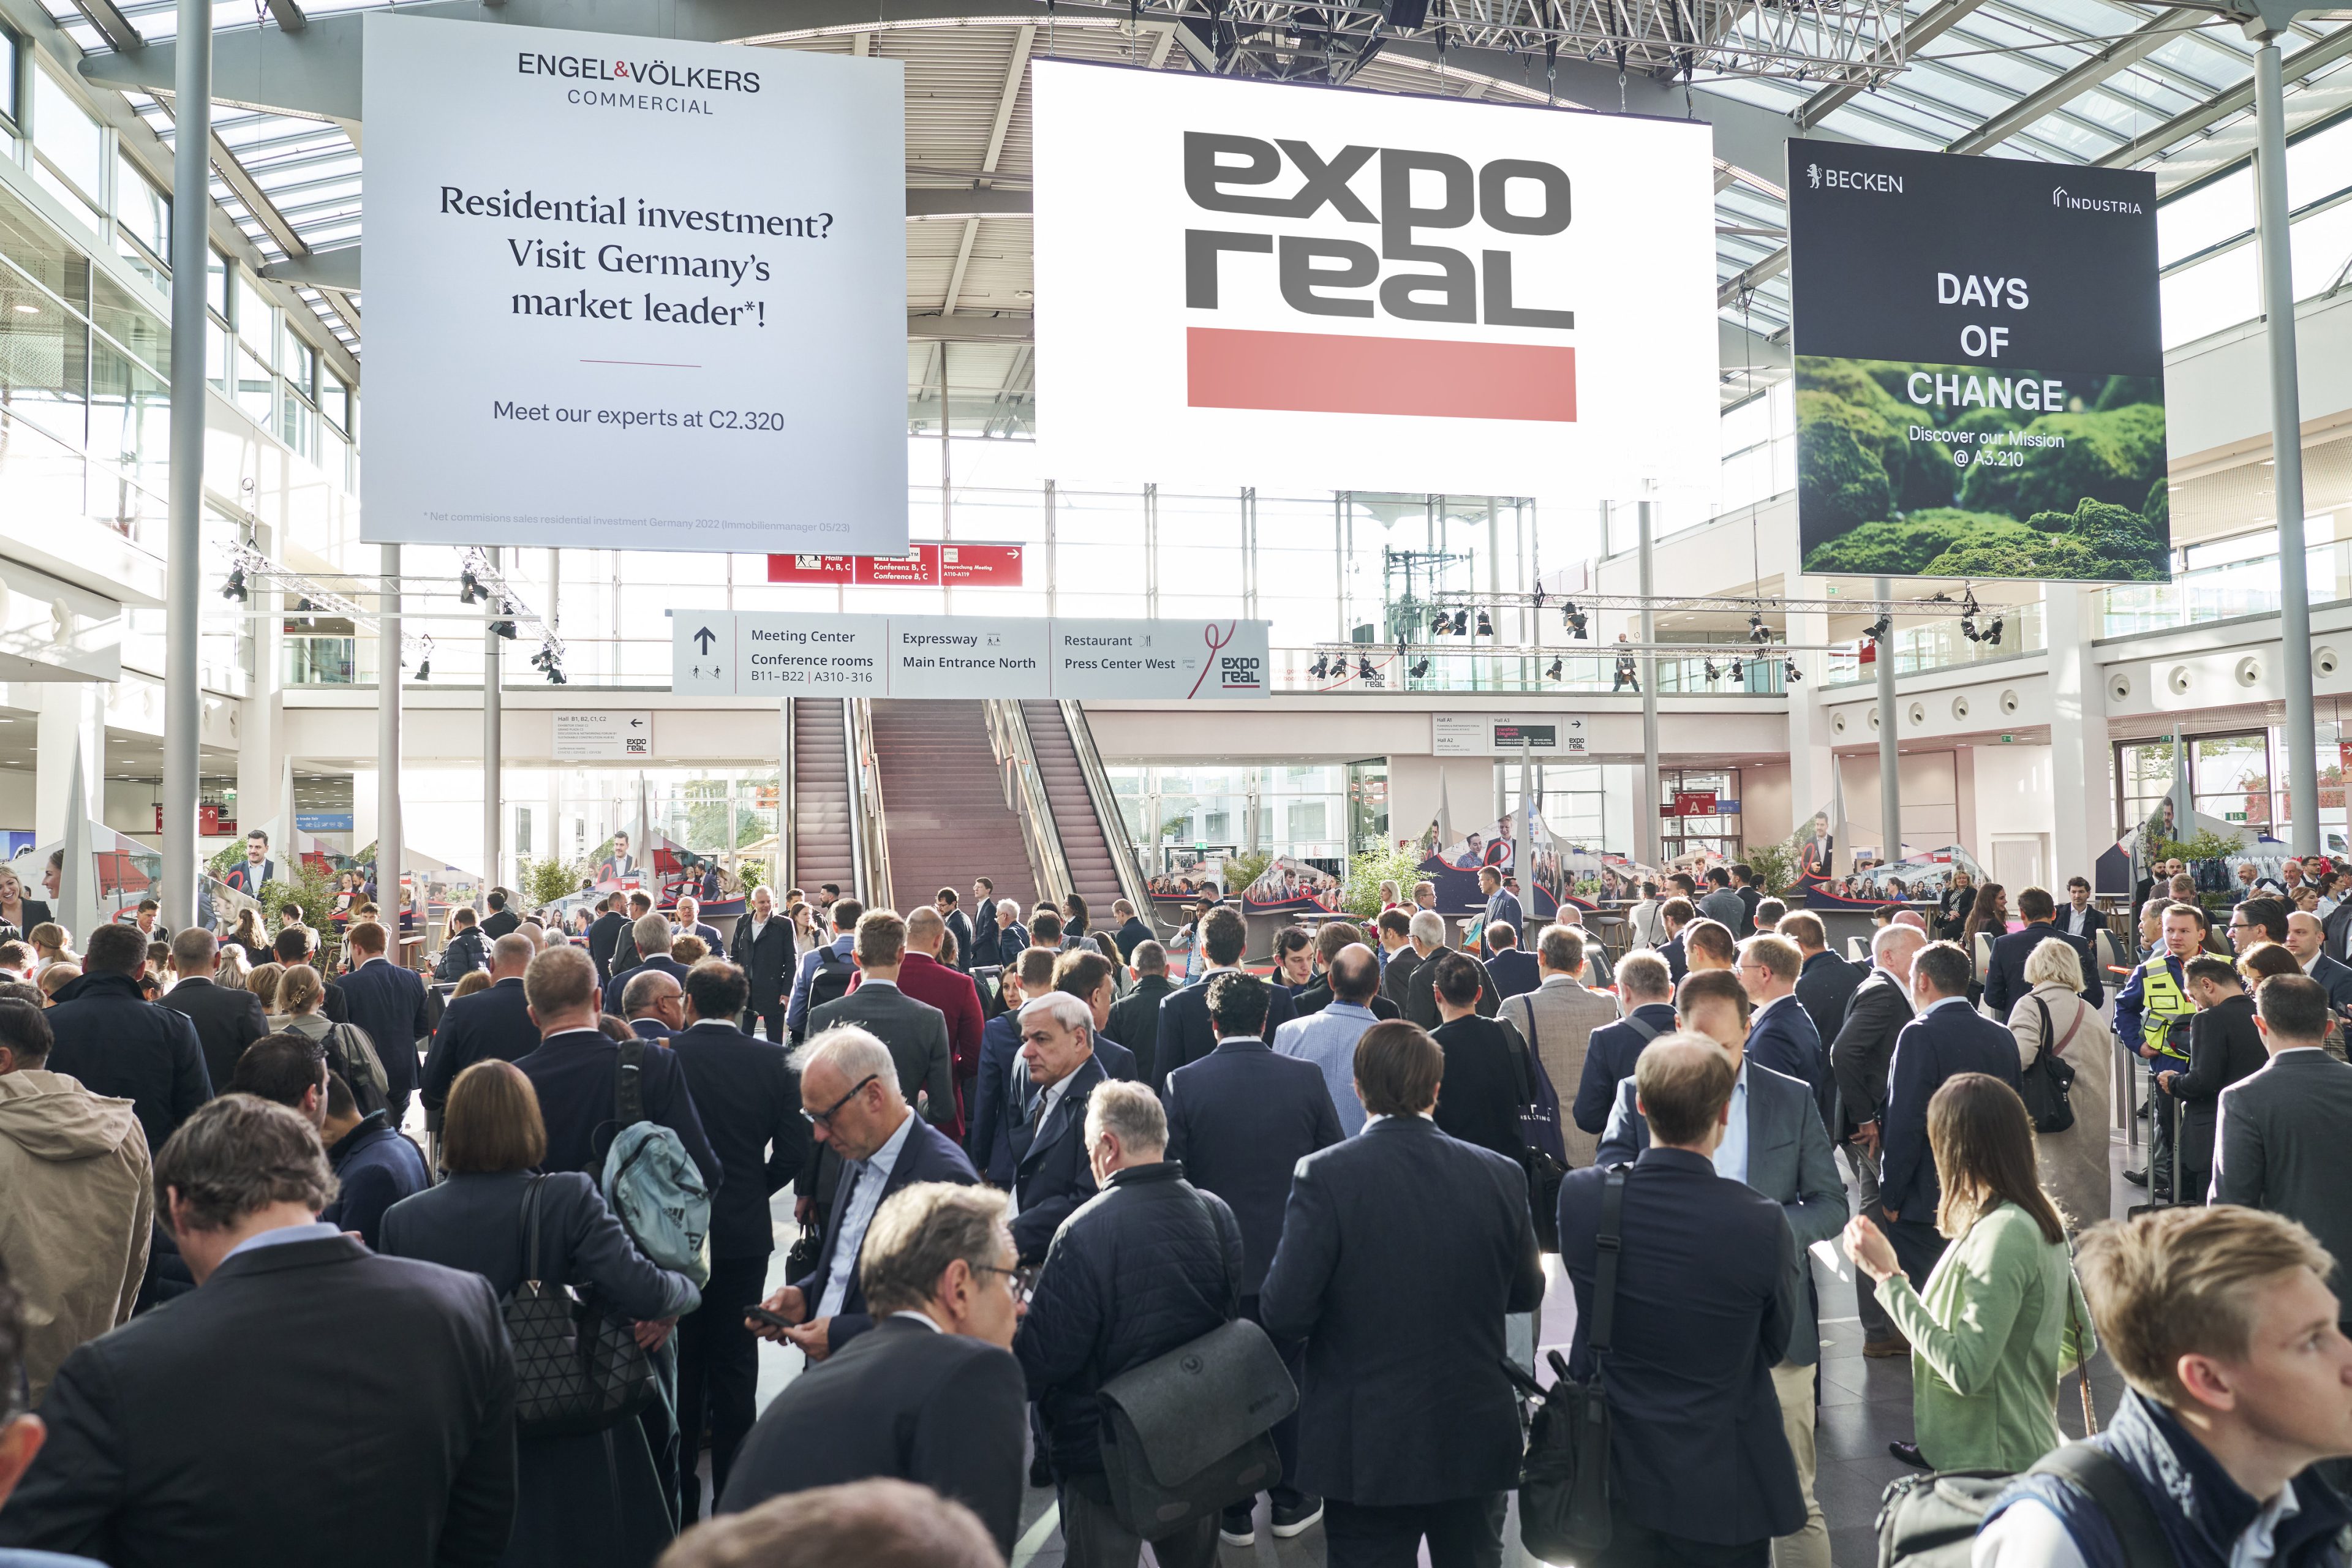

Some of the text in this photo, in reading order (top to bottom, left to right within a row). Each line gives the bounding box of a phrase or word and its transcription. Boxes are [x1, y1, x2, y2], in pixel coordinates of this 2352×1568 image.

[518, 52, 760, 94] ENGEL&VÖLKERS
[568, 89, 713, 115] COMMERCIAL
[1826, 170, 1902, 193] BECKEN
[1184, 130, 1571, 258] expo
[441, 187, 833, 238] Residential investment?
[2067, 197, 2141, 214] INDUSTRIA
[507, 239, 769, 287] Visit Germany’s
[1938, 273, 2029, 309] DAYS
[512, 289, 632, 320] market
[1961, 325, 2008, 357] OF
[1907, 372, 2063, 412] CHANGE
[495, 401, 783, 431] Meet our experts at C2.320
[1910, 426, 2064, 448] Discover our Mission
[1954, 451, 2023, 467] @ A3.210
[431, 512, 448, 521] Net
[451, 513, 511, 522] commisions
[513, 514, 538, 523] sales
[541, 515, 590, 524] residential
[594, 516, 647, 526] investment
[650, 518, 693, 529] Germany
[696, 519, 719, 528] 2022
[722, 521, 817, 533] (Immobilienmanager
[820, 523, 850, 533] 05/23)
[752, 630, 855, 644] Meeting Center
[903, 633, 978, 647] Expressway
[1065, 636, 1132, 646] Restaurant
[752, 654, 827, 665] Conference
[904, 657, 1035, 668] Main Entrance North
[1066, 659, 1175, 668] Press Center West
[1221, 658, 1259, 671] expo
[1689, 802, 1700, 813] A
